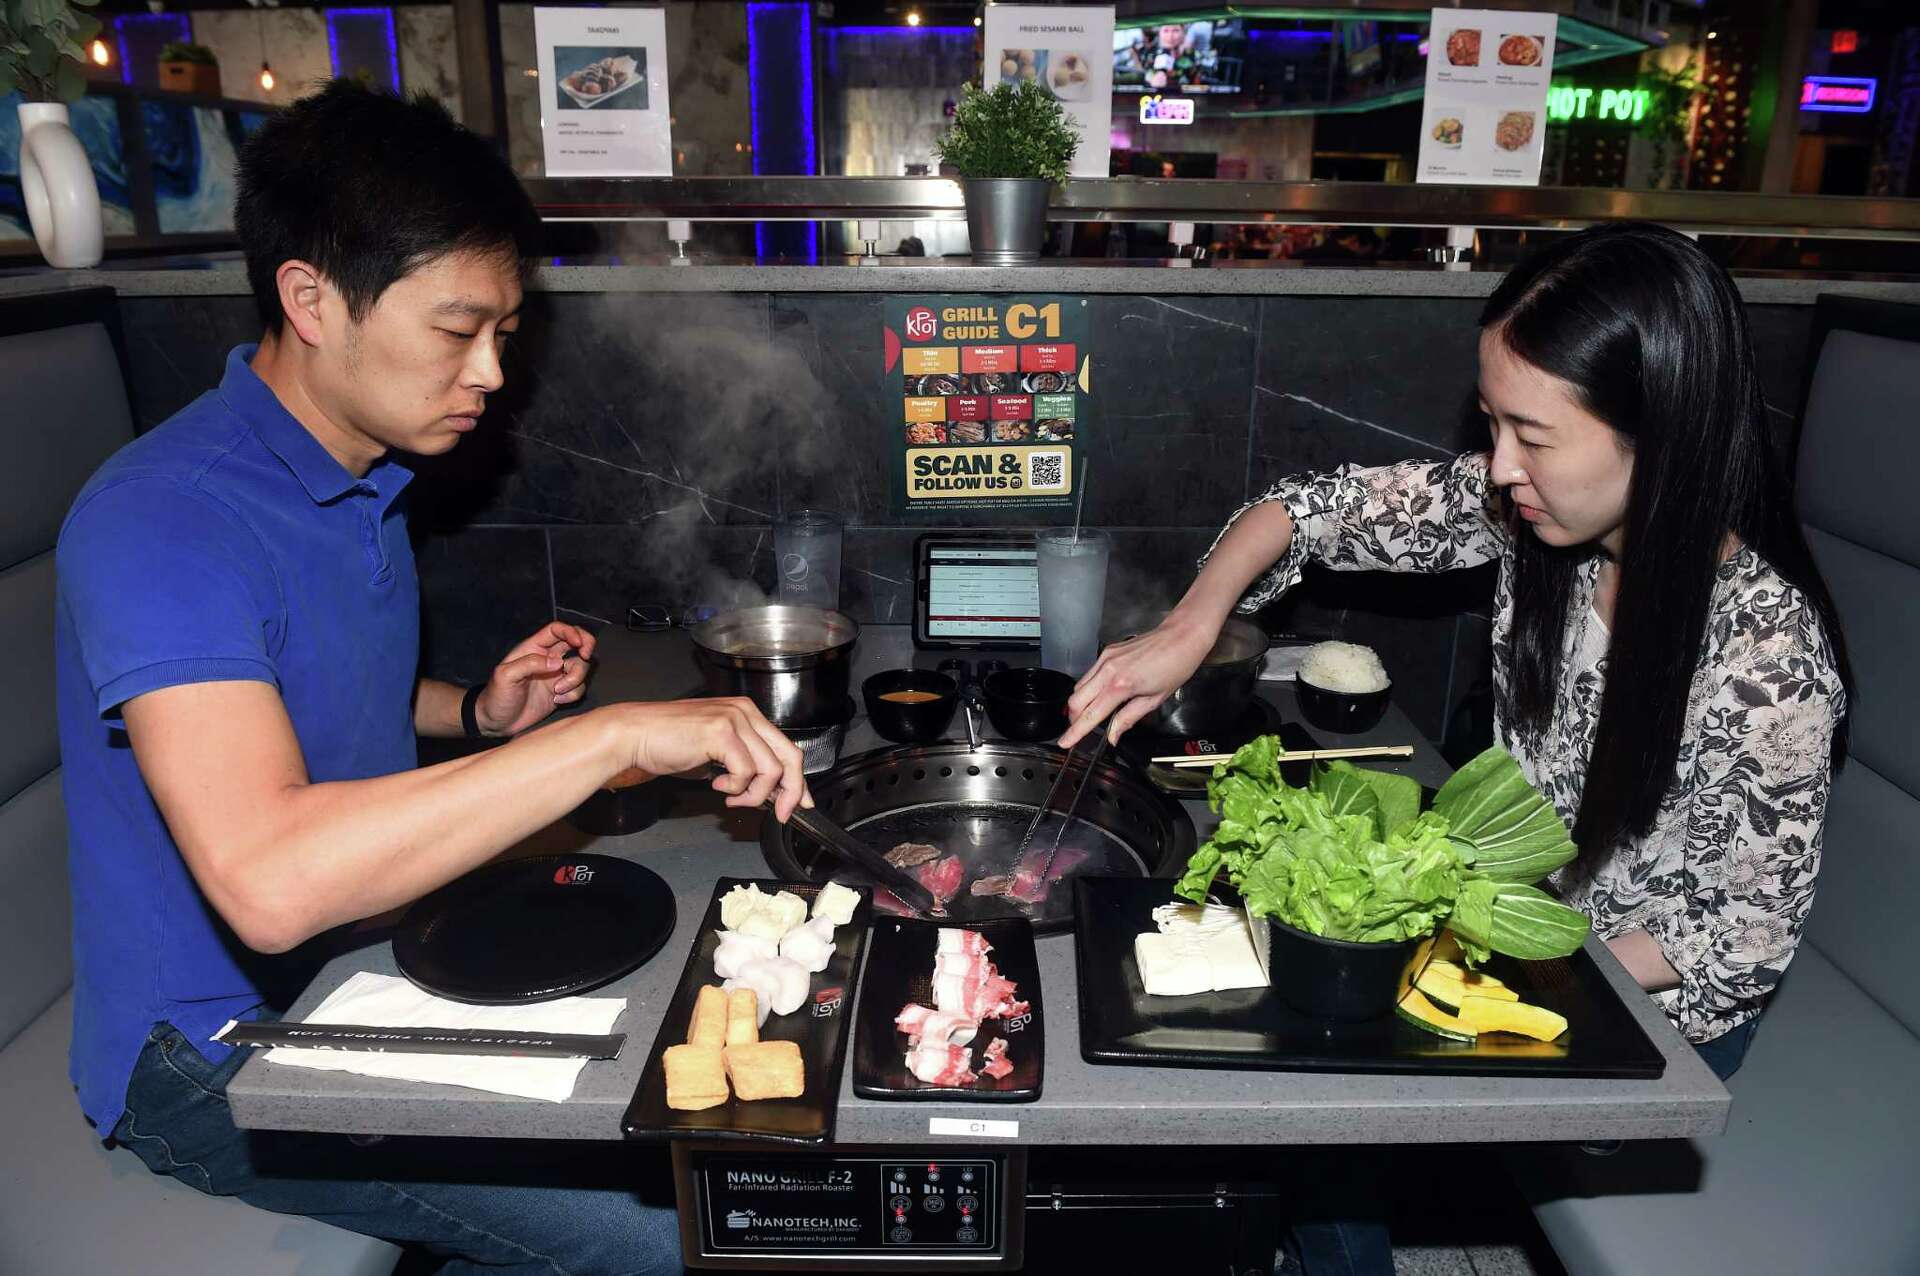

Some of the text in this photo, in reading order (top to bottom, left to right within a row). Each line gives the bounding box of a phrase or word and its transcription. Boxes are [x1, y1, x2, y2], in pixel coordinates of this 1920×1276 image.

[1547, 87, 1650, 121] HOT POT
[942, 306, 998, 322] GRILL
[1005, 303, 1060, 340] C1
[942, 325, 1000, 340] GUIDE
[1042, 394, 1072, 403] Veggies
[913, 453, 1022, 477] SCAN &
[914, 477, 1008, 490] FOLLOW US
[970, 1123, 985, 1132] C1
[727, 1171, 776, 1184] NANO
